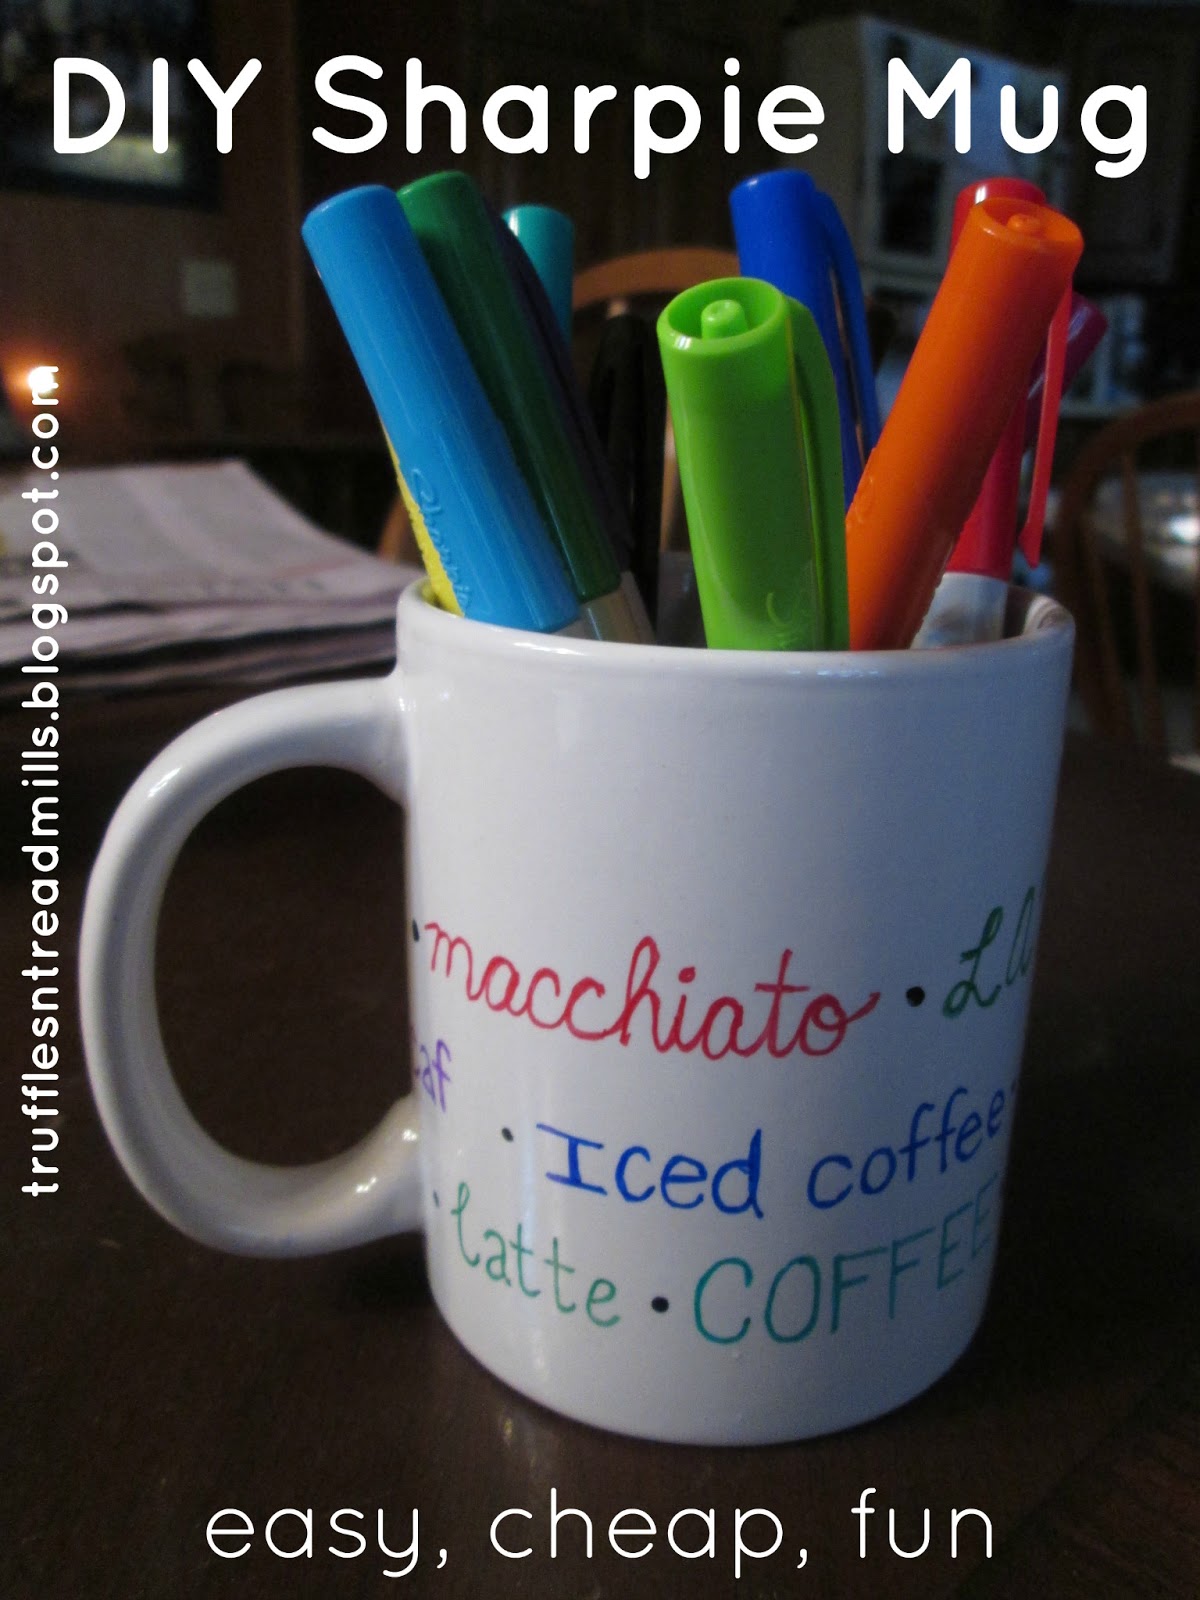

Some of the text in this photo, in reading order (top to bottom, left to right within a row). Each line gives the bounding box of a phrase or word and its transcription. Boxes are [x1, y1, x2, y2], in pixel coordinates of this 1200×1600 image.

[424, 922, 881, 1060] macchiato
[536, 1086, 1006, 1219] Iced coffee
[451, 1171, 998, 1344] latte COFFEE
